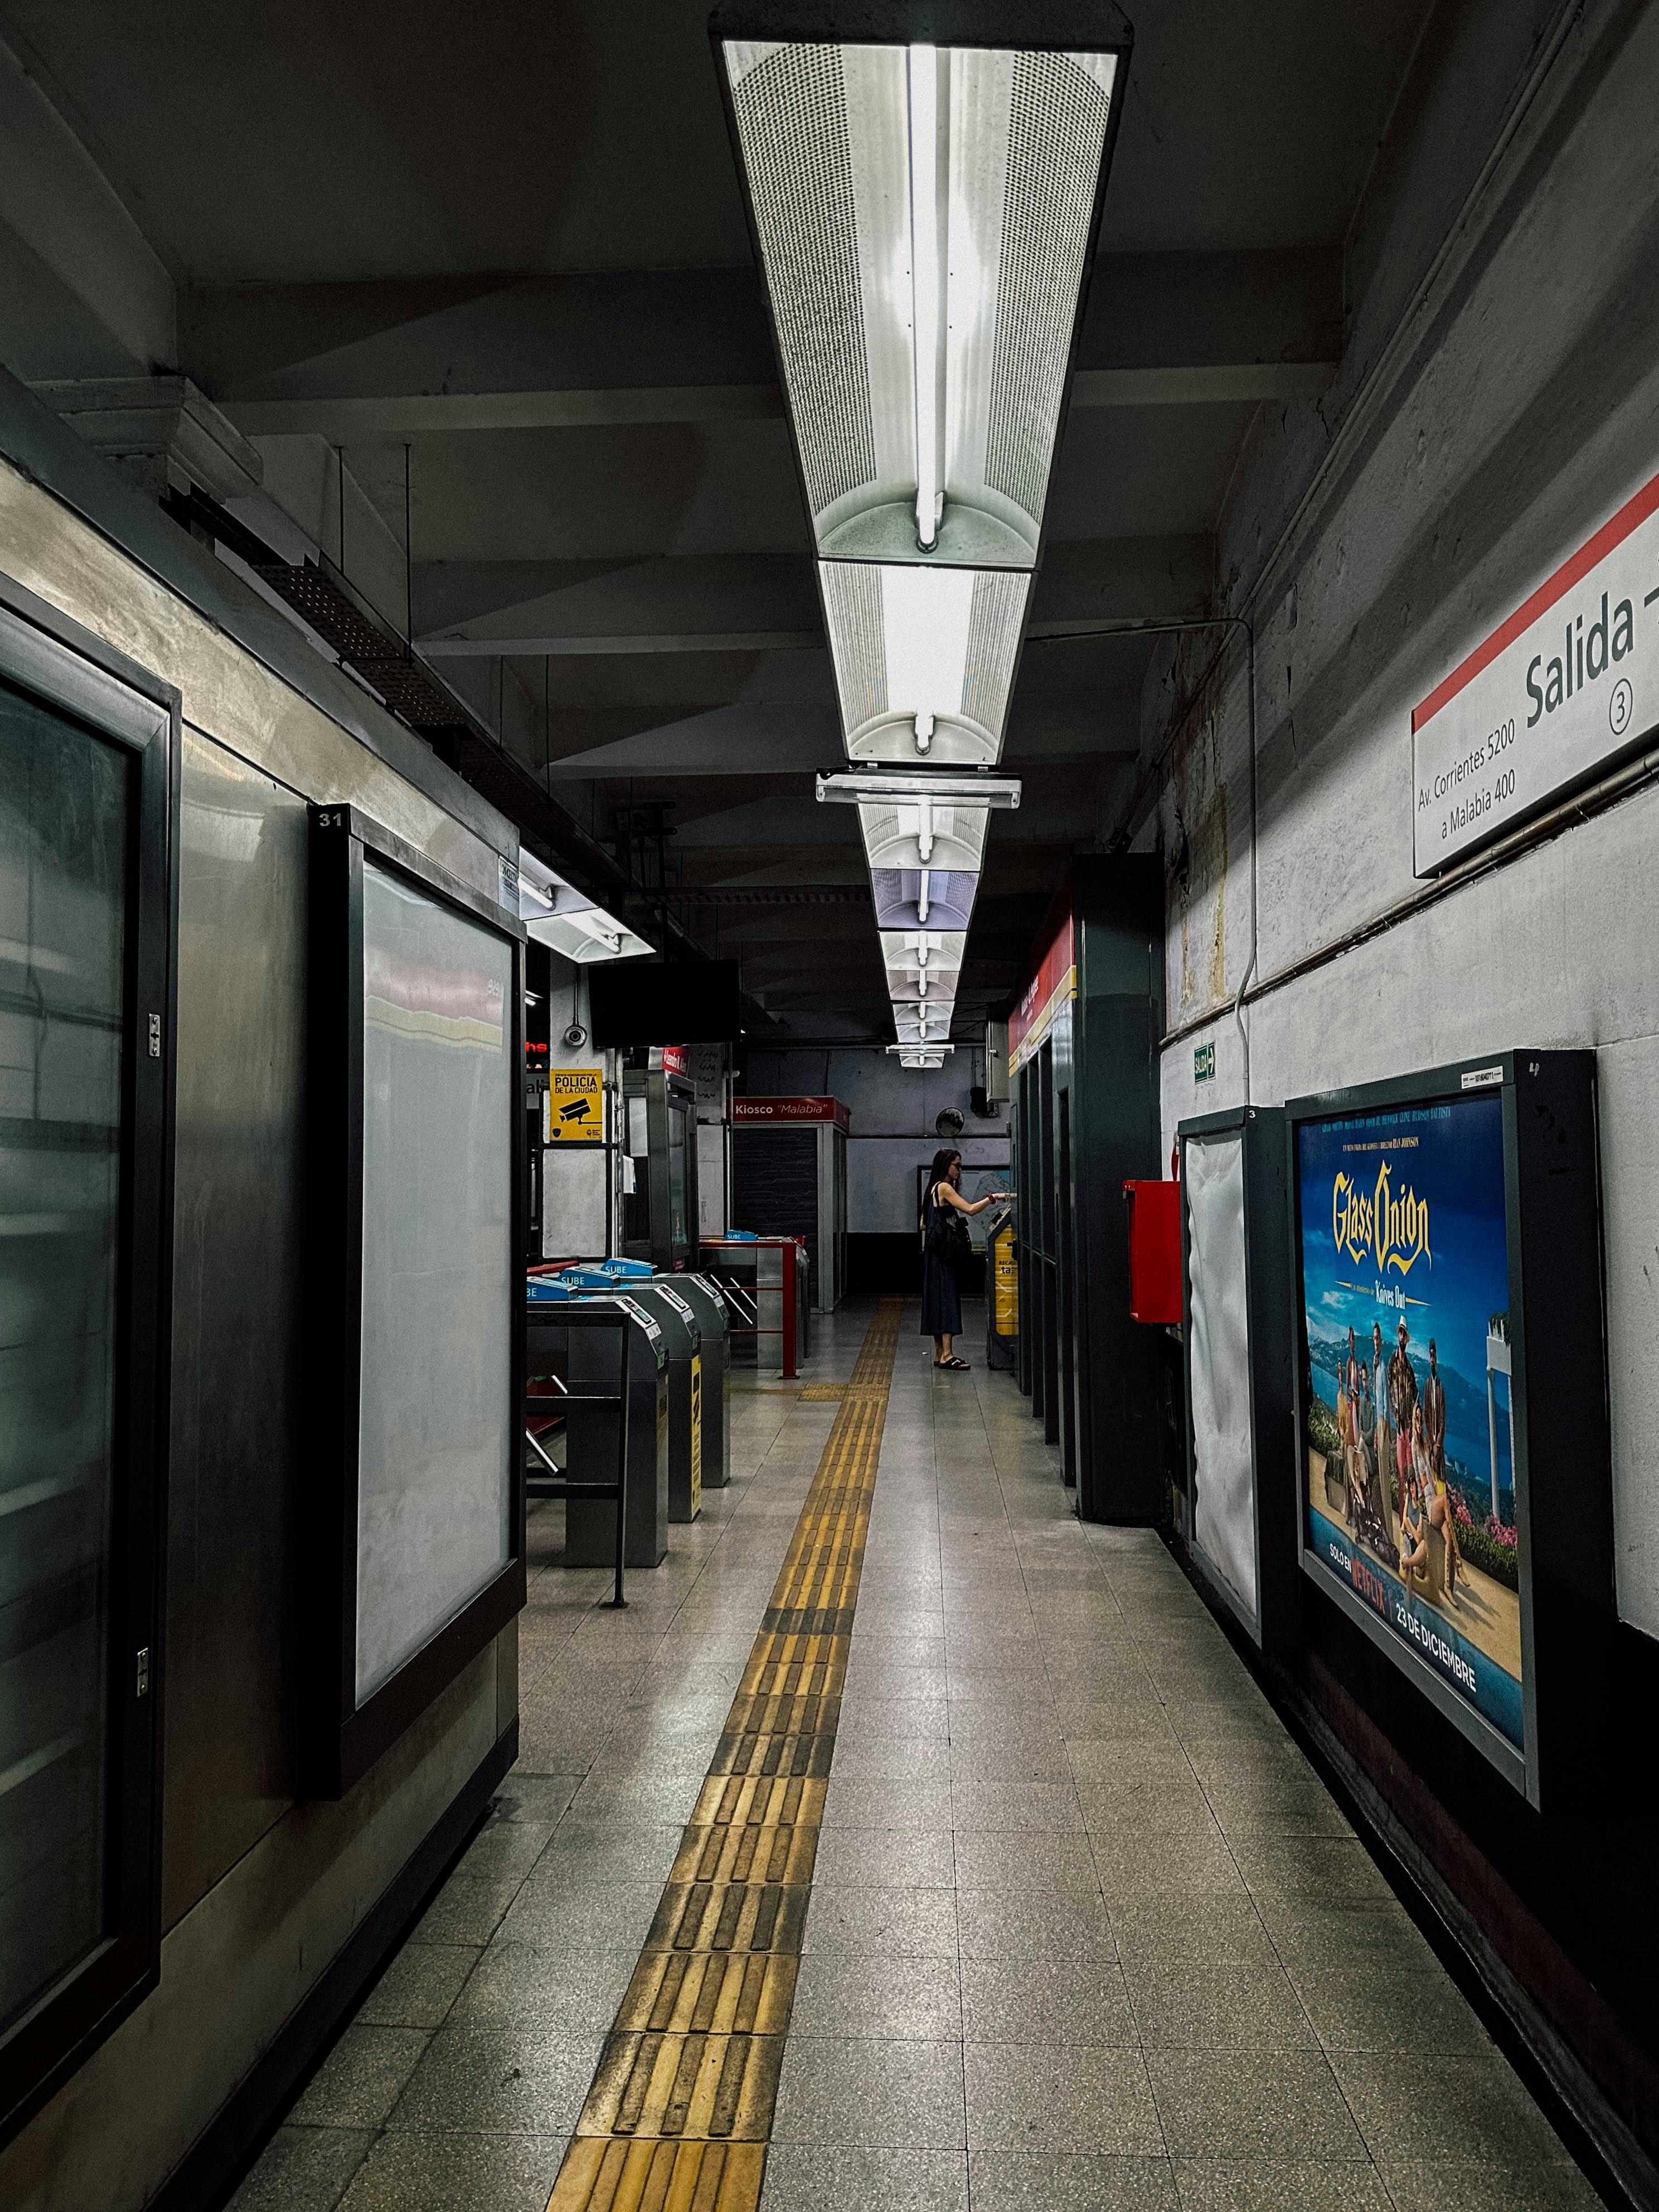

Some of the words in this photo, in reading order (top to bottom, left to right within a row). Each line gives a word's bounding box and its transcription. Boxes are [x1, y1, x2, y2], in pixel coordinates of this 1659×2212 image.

[1526, 591, 1633, 728] Salida
[1616, 692, 1625, 724] 3
[1418, 788, 1432, 812] Av.
[1434, 747, 1485, 798] Corrientes
[1488, 718, 1515, 761] 5200
[1442, 819, 1447, 840] a
[1451, 788, 1492, 835] Malabia
[1495, 768, 1515, 804] 400
[319, 813, 342, 827] 31
[555, 1076, 597, 1087] POLICIA
[735, 1104, 773, 1114] Kiosco
[1249, 1110, 1256, 1118] 3
[1332, 1171, 1374, 1265] Glass
[1374, 1160, 1432, 1276] Onion
[561, 1277, 585, 1286] SUBE
[605, 1265, 627, 1274] SUBE
[527, 1288, 537, 1297] BE
[1375, 1279, 1394, 1307] Knives
[1395, 1286, 1405, 1309] Out
[1330, 1543, 1344, 1567] SOLO
[1344, 1558, 1352, 1574] EN
[1351, 1560, 1385, 1614] NETFLIX
[1396, 1603, 1408, 1629] 23
[1408, 1613, 1420, 1642] DE
[1421, 1626, 1477, 1693] DICIEMBRE
